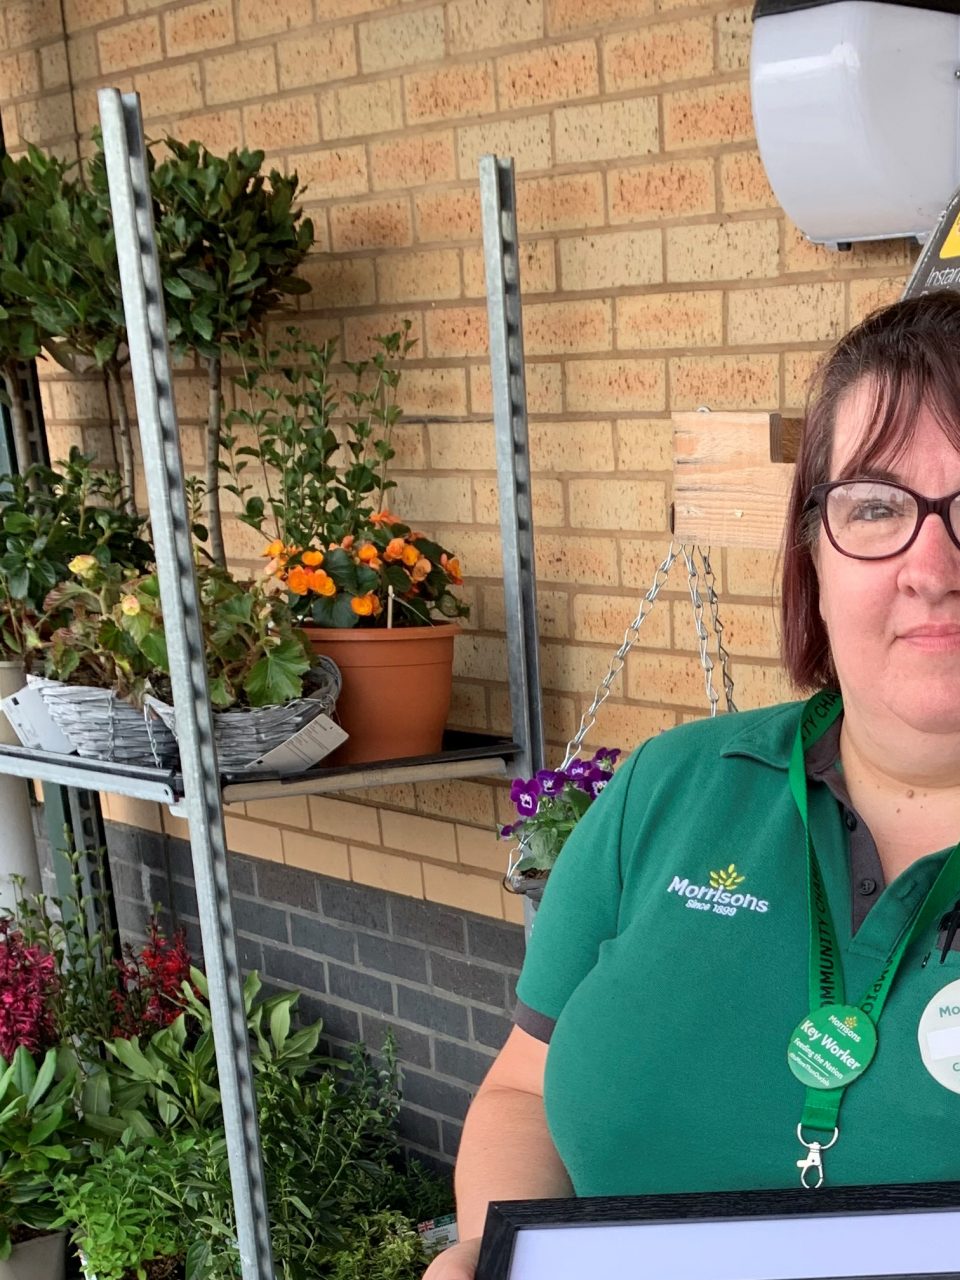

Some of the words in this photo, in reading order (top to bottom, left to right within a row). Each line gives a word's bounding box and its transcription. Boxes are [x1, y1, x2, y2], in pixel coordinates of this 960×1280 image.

[666, 875, 769, 913] Morrisons
[685, 899, 711, 911] Since
[712, 903, 738, 917] 1899
[828, 1014, 862, 1043] Morrisons
[800, 1019, 822, 1041] Key
[820, 1033, 861, 1070] Worker
[813, 1052, 824, 1064] the
[823, 1060, 844, 1080] Nation
